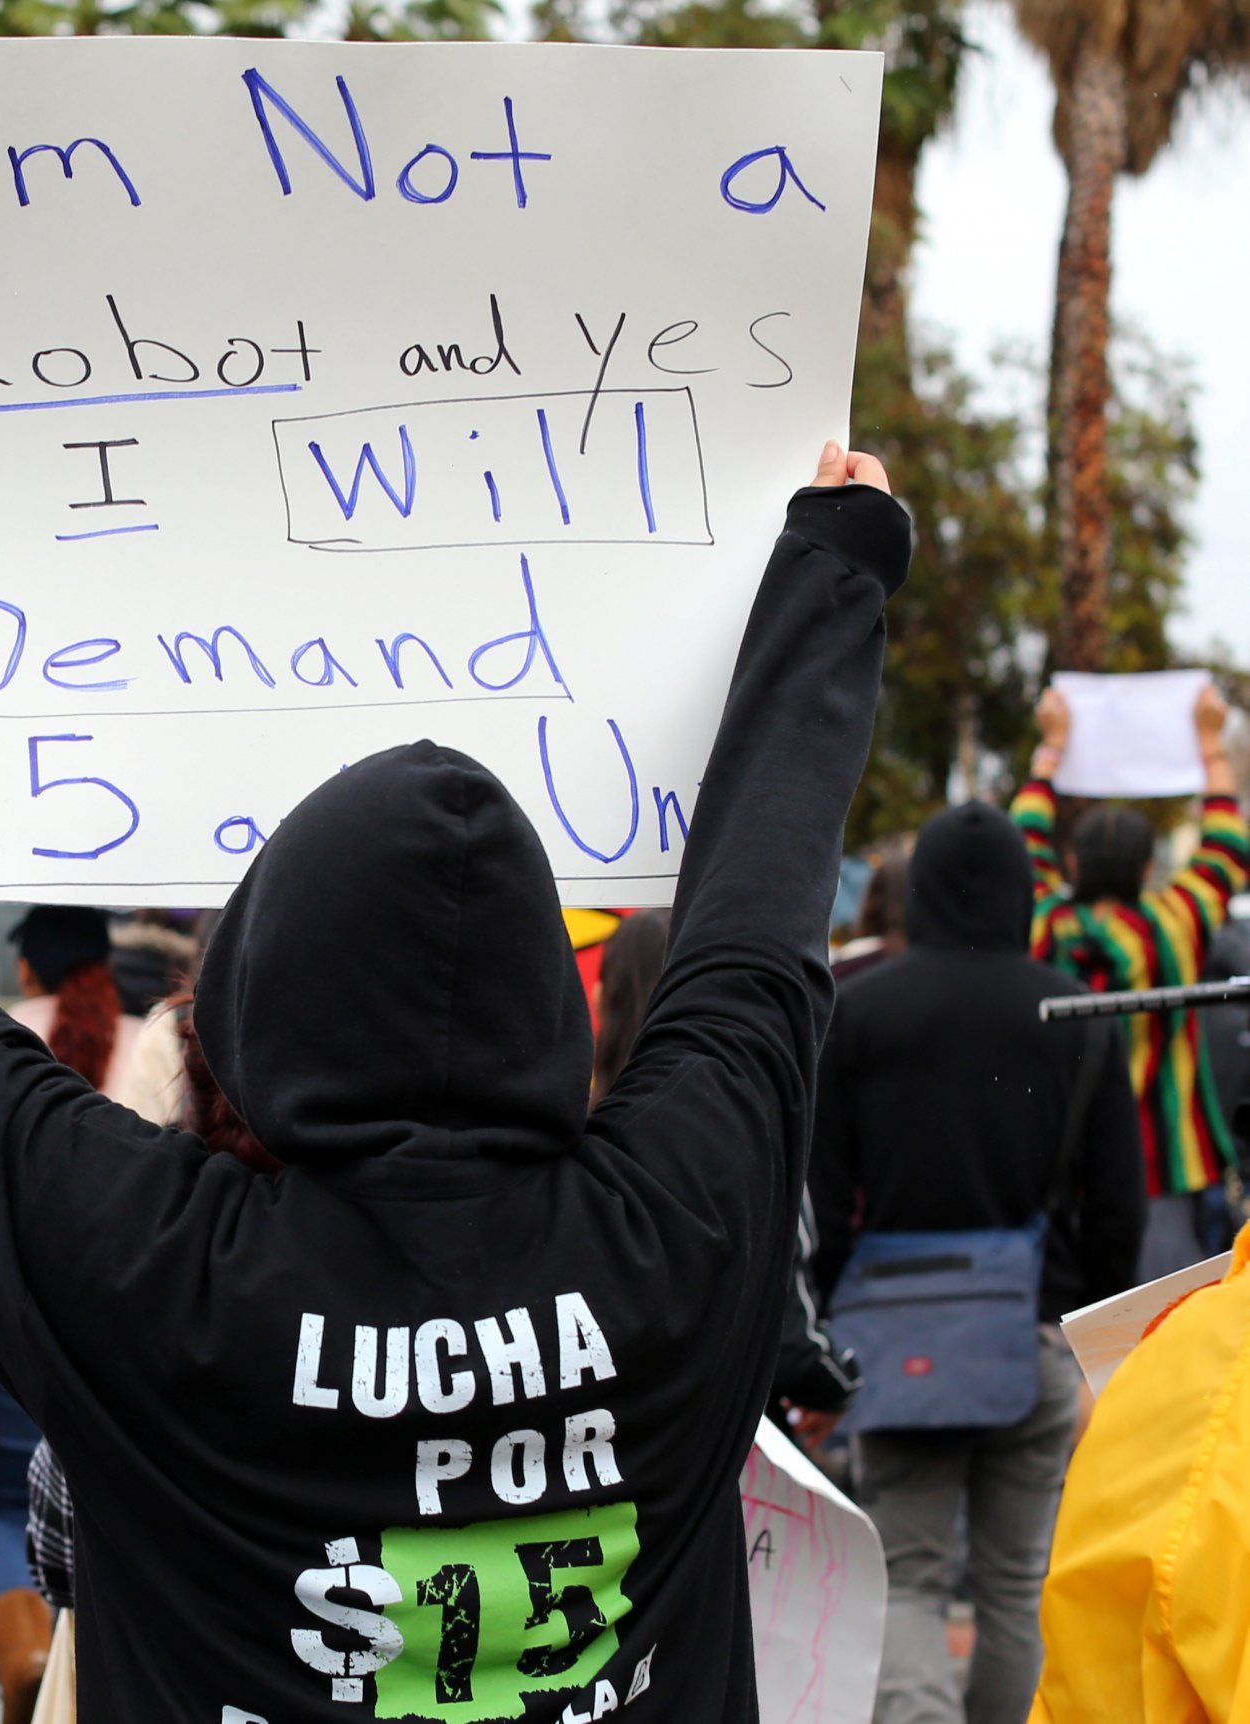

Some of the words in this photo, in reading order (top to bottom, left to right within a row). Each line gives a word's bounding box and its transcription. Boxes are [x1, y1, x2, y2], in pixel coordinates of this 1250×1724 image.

[242, 67, 552, 209] Not
[721, 144, 826, 214] a
[399, 293, 522, 377] and
[63, 438, 147, 508] I
[309, 402, 656, 533] Will
[292, 1292, 617, 1418] LUCHA
[416, 1408, 624, 1515] POR
[290, 1535, 607, 1703] $15
